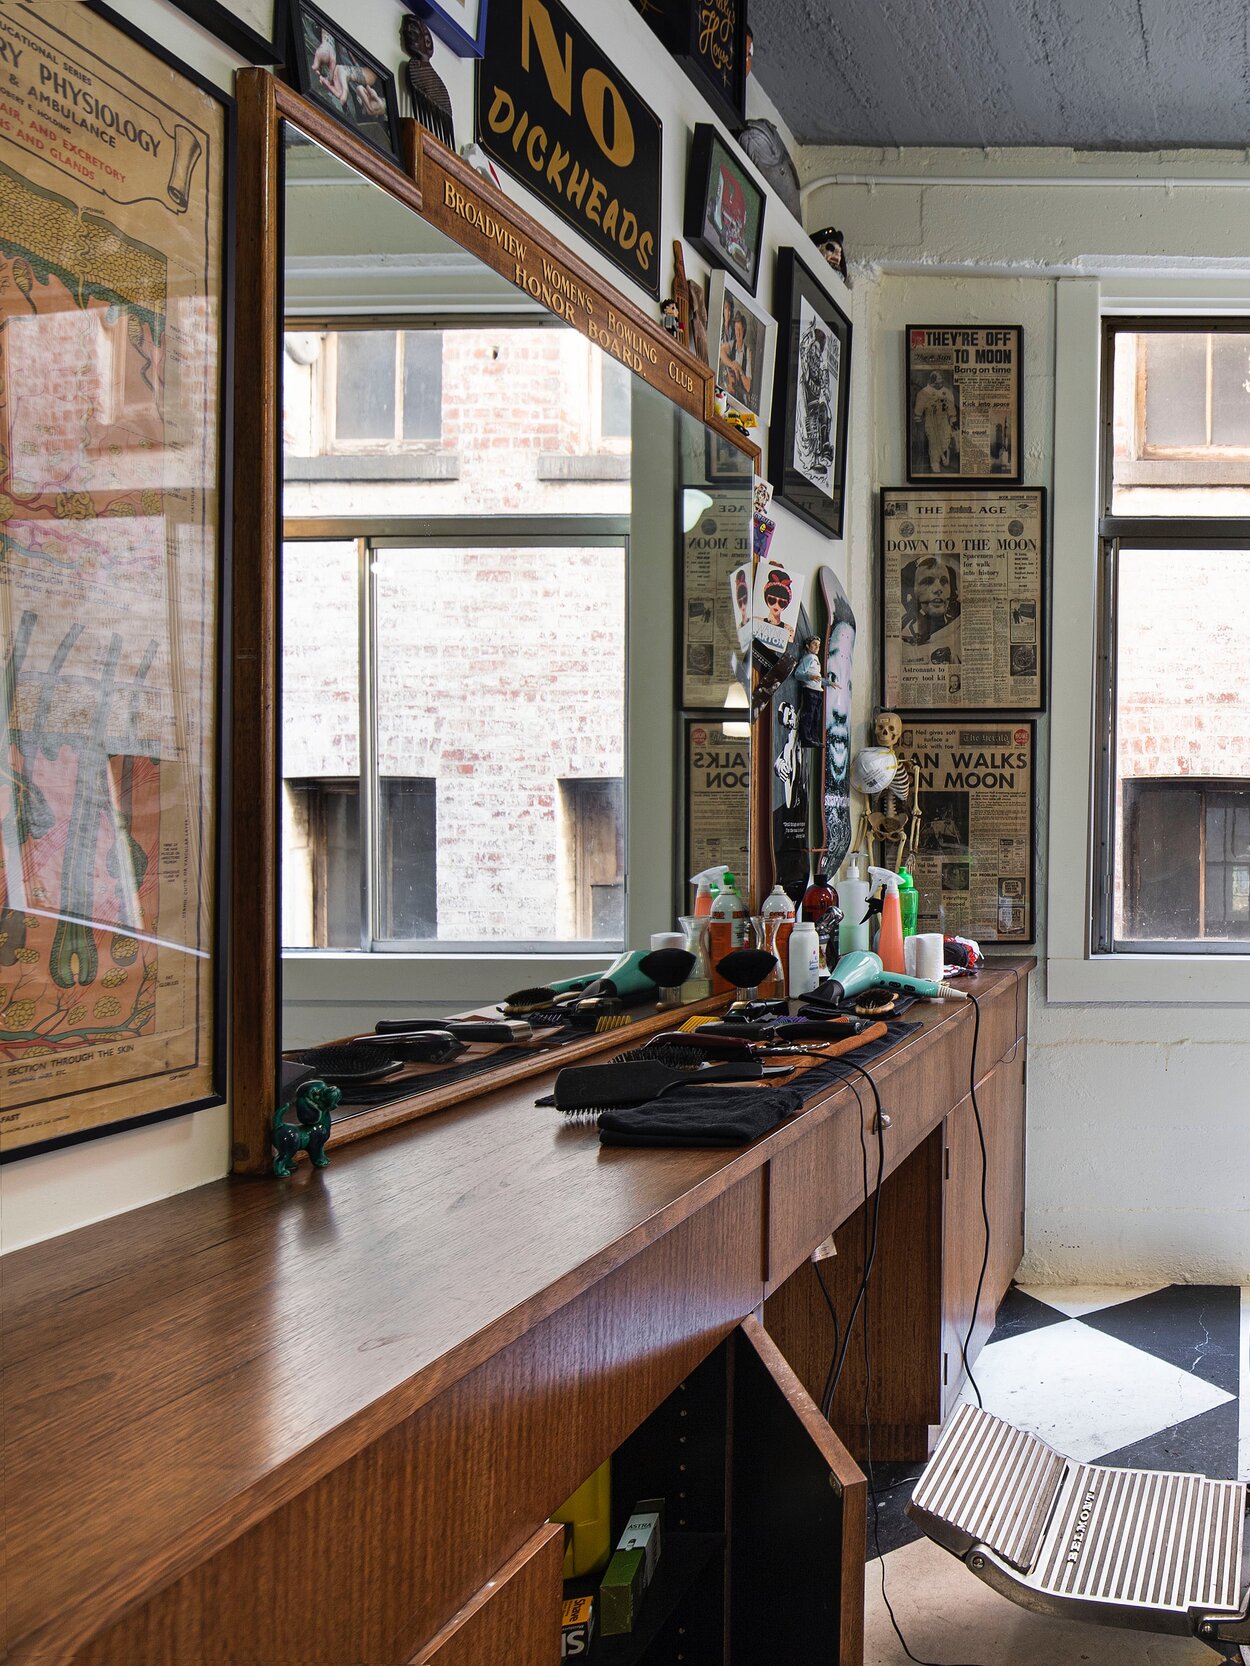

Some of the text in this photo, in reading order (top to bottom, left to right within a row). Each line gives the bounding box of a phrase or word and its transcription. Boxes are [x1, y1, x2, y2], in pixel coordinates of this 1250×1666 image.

[700, 9, 732, 70] House
[63, 63, 92, 86] SERIES
[521, 0, 635, 167] NO
[9, 74, 116, 148] & AMBULANCE
[38, 110, 71, 134] HOLDING
[40, 63, 160, 158] PHYSIOLOGY
[16, 130, 44, 150] AND
[50, 148, 95, 181] GLANDS
[30, 121, 56, 141] AND
[63, 138, 126, 183] EXCRETORY
[488, 85, 653, 271] DICKHEADS
[443, 180, 527, 262] BROADVIEW
[541, 258, 593, 315] WOMEN'S
[608, 311, 657, 364] BOWLING
[514, 263, 646, 376] HONOR BOARD.
[926, 332, 1011, 346] THEY'RE OFF
[954, 350, 1011, 364] TO MOON
[955, 366, 976, 374] Bang
[887, 539, 1037, 551] DOWN TO THE MOON
[19, 570, 63, 586] THROUGH
[69, 581, 85, 590] THE
[951, 753, 1027, 769] WALKS
[944, 772, 1014, 788] MOON
[7, 1044, 134, 1077] SECTION THROUGH THE SKIN
[1068, 1491, 1094, 1563] BELMONT
[570, 1599, 586, 1622] Shave
